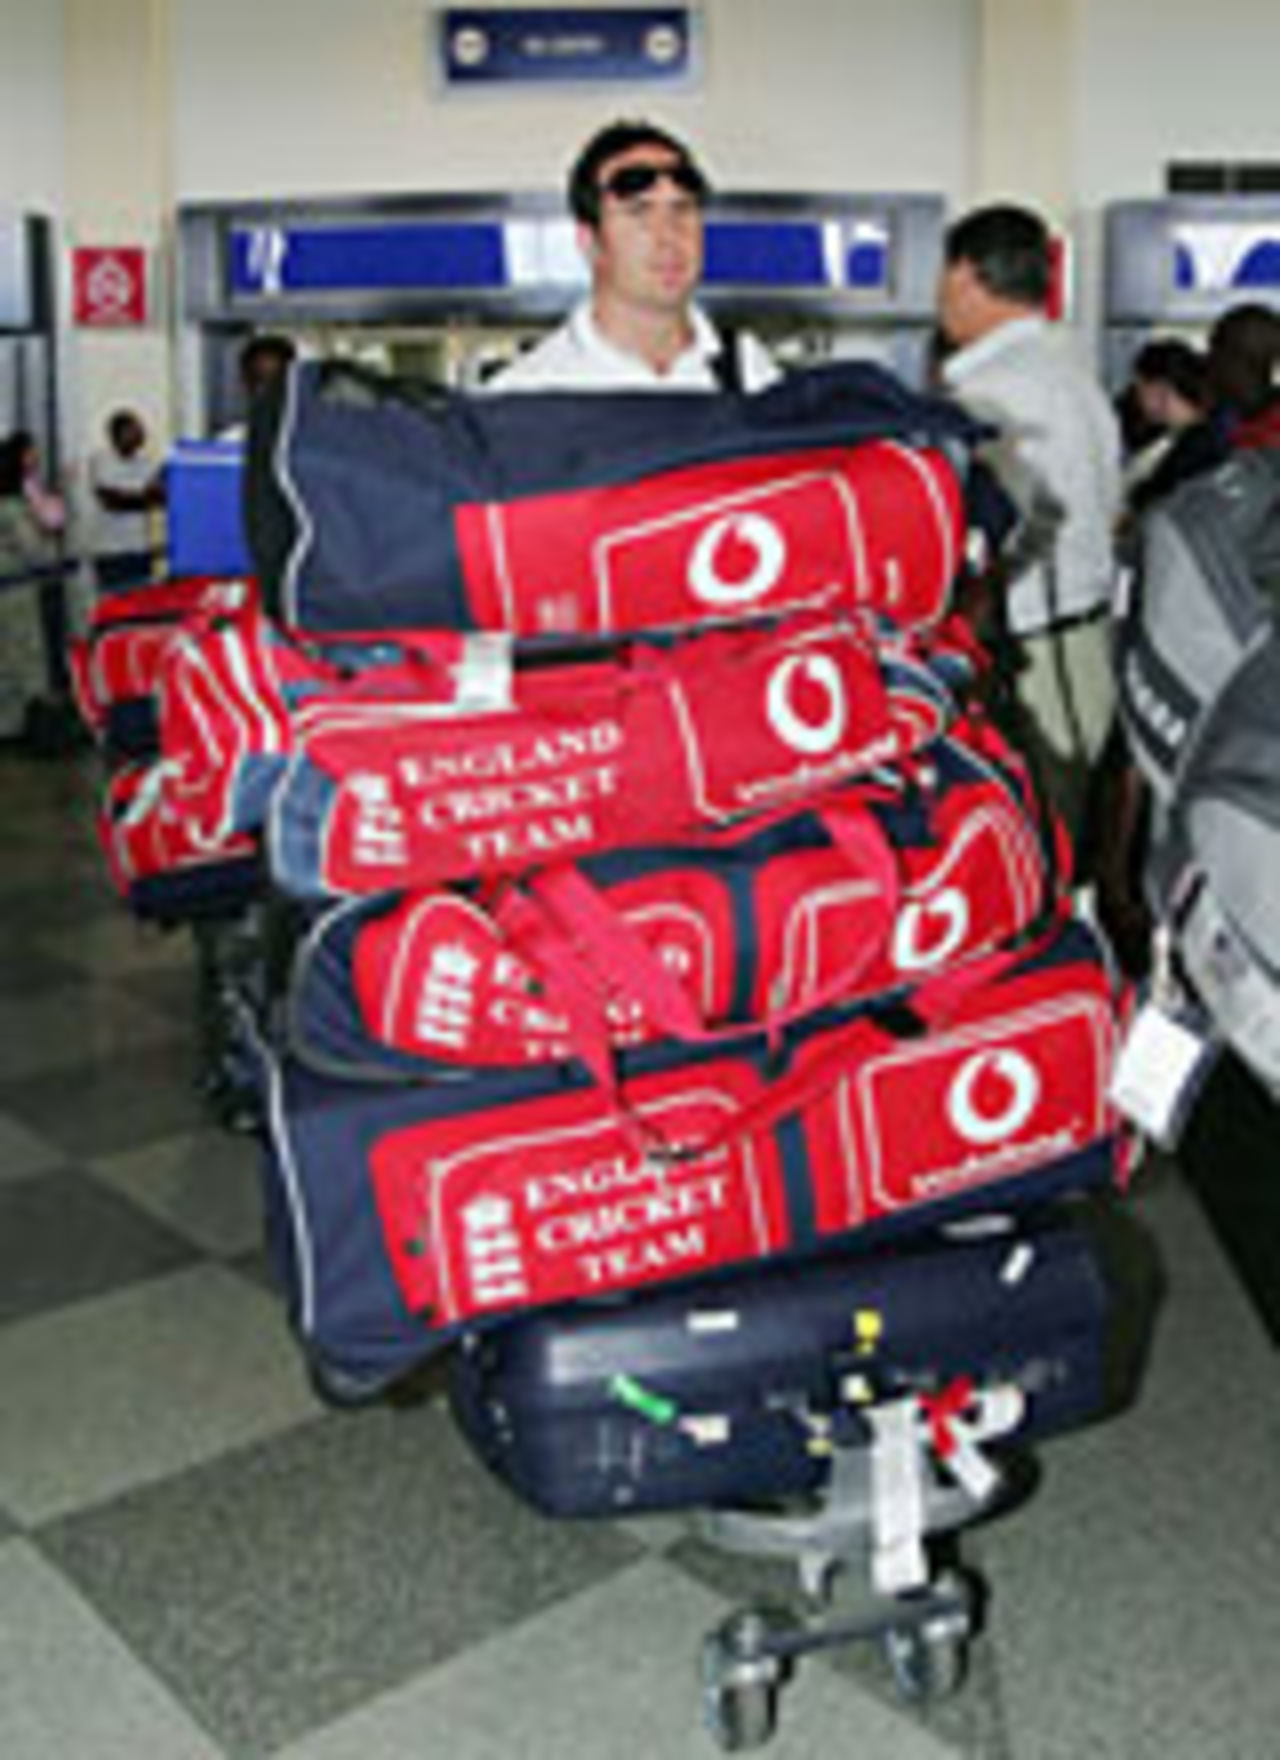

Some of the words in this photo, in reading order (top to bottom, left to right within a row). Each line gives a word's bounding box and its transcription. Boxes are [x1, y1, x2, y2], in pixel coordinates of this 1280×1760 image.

[398, 718, 624, 788] ENGLAND
[421, 763, 618, 832] CRICKET
[466, 813, 595, 861] TEAM
[534, 1175, 726, 1250] CRICKET
[576, 1223, 706, 1283] TEAM
